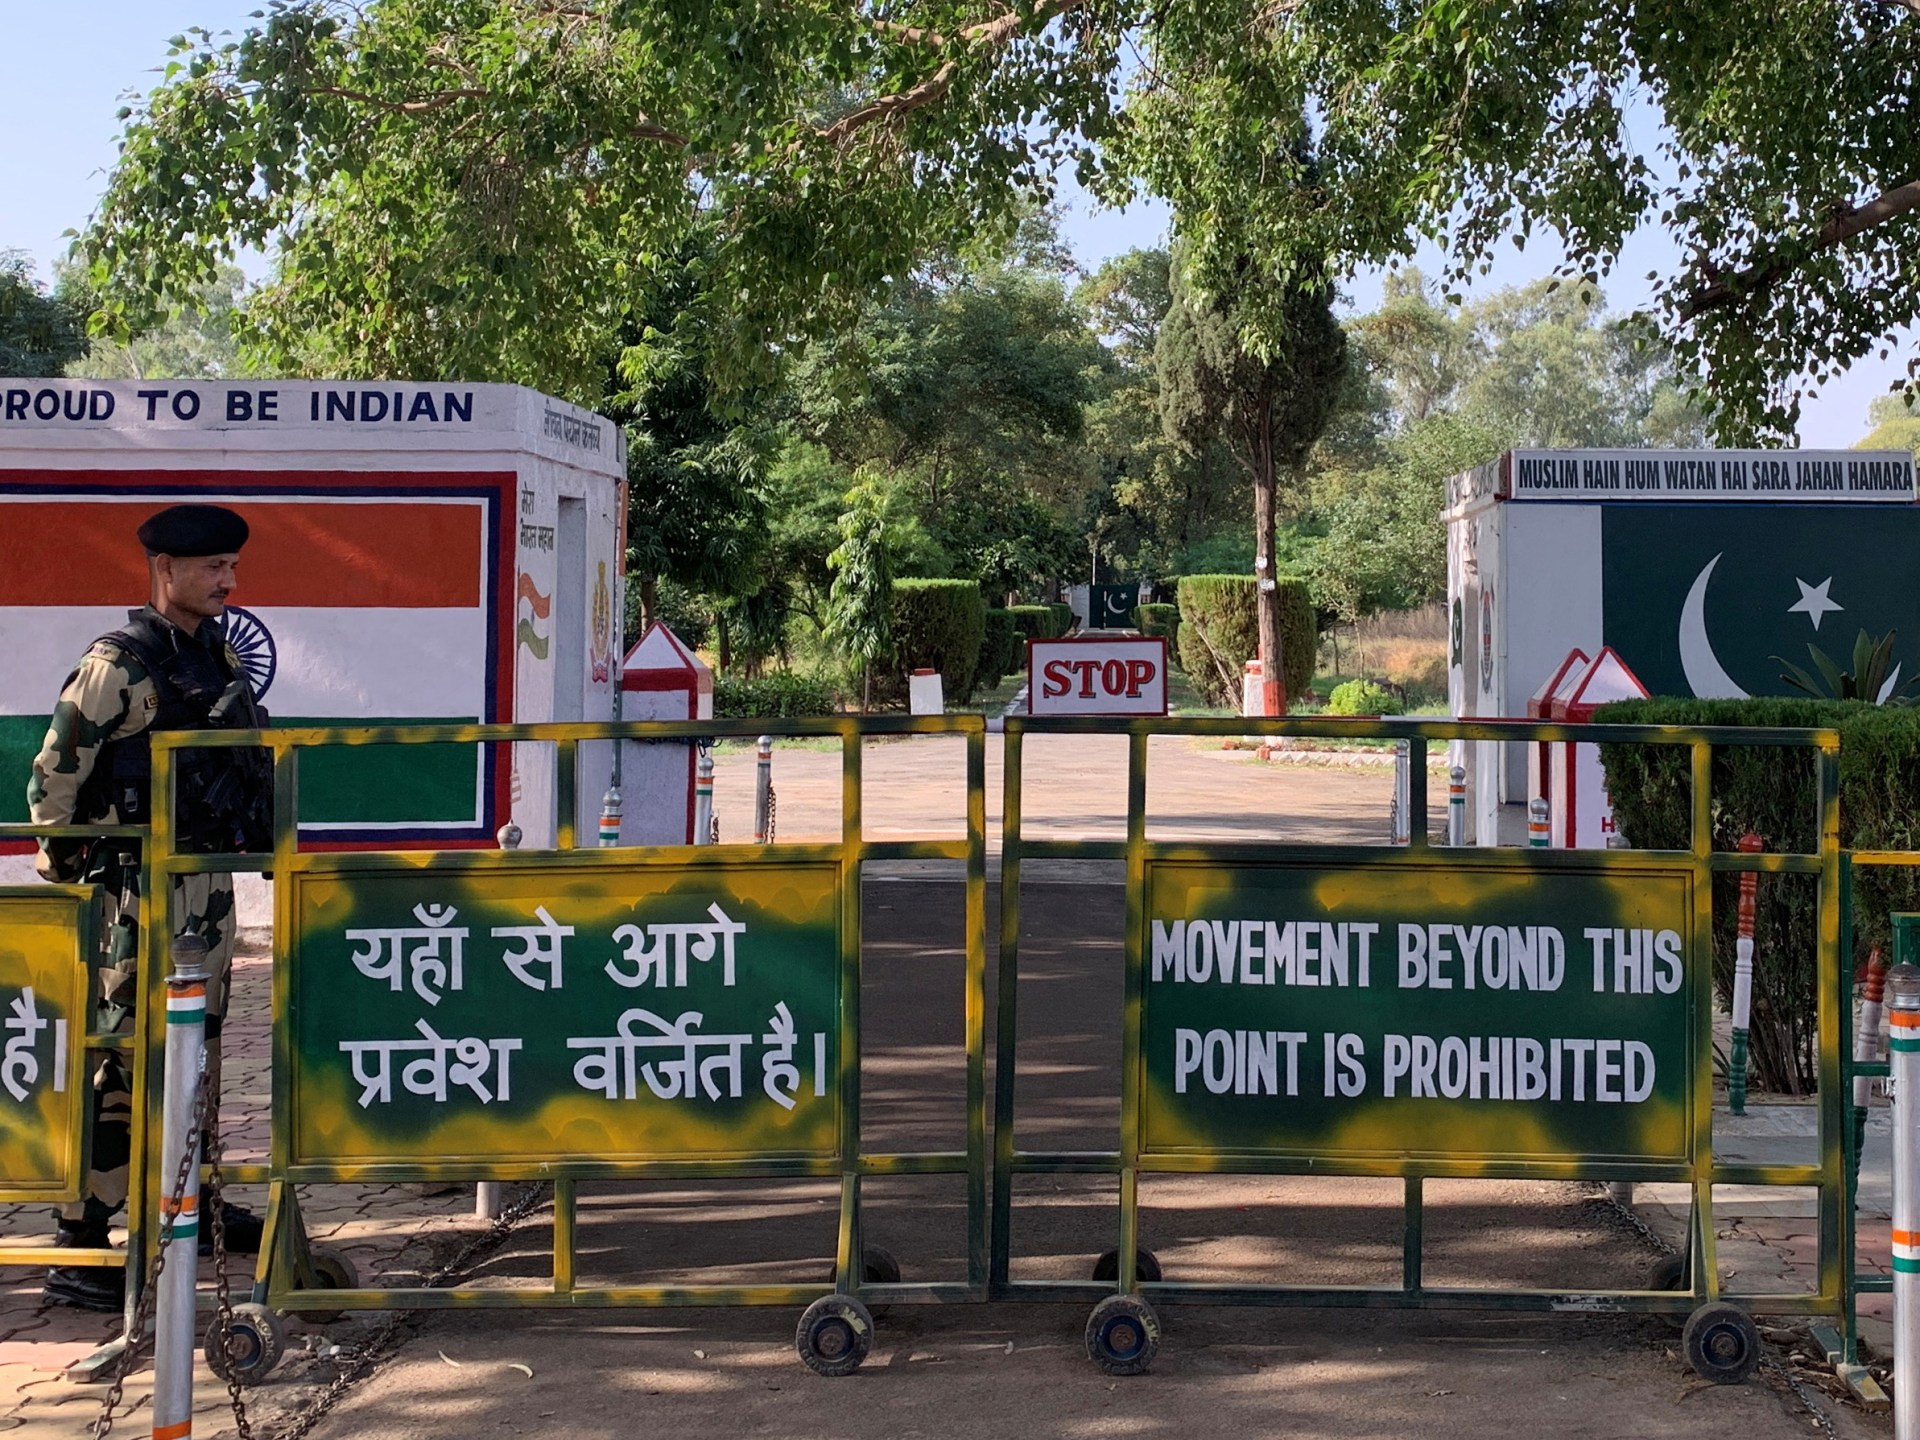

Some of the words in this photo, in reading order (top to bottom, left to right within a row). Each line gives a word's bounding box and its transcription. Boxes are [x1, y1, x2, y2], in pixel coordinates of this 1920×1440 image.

[0, 388, 115, 421] ROUD
[138, 389, 200, 421] TO
[227, 390, 278, 422] BE
[311, 390, 473, 422] INDIAN
[1518, 459, 1579, 489] MUSLIM
[1584, 459, 1620, 490] HAIN
[1625, 460, 1660, 490] HUM
[1664, 461, 1718, 490] WATAN
[1721, 461, 1748, 490] HAI
[1751, 461, 1792, 491] SARA
[1795, 461, 1844, 491] JAHAN
[1848, 461, 1914, 491] HAMARA
[521, 481, 535, 515] मेरा
[520, 518, 537, 550] भारत
[538, 526, 555, 554] महान
[1043, 659, 1156, 699] STOP
[346, 903, 469, 1006] यहाँ
[491, 905, 575, 991] से
[604, 901, 746, 988] आगे
[1151, 919, 1379, 988] MOVEMENT
[1398, 923, 1565, 991] BEYOND
[1584, 927, 1684, 994] THIS
[339, 1018, 523, 1108] प्रवेश
[566, 1008, 753, 1102] वर्जित
[1175, 1028, 1307, 1096] POINT
[1324, 1032, 1366, 1098] IS
[1383, 1034, 1656, 1103] PROHIBITED
